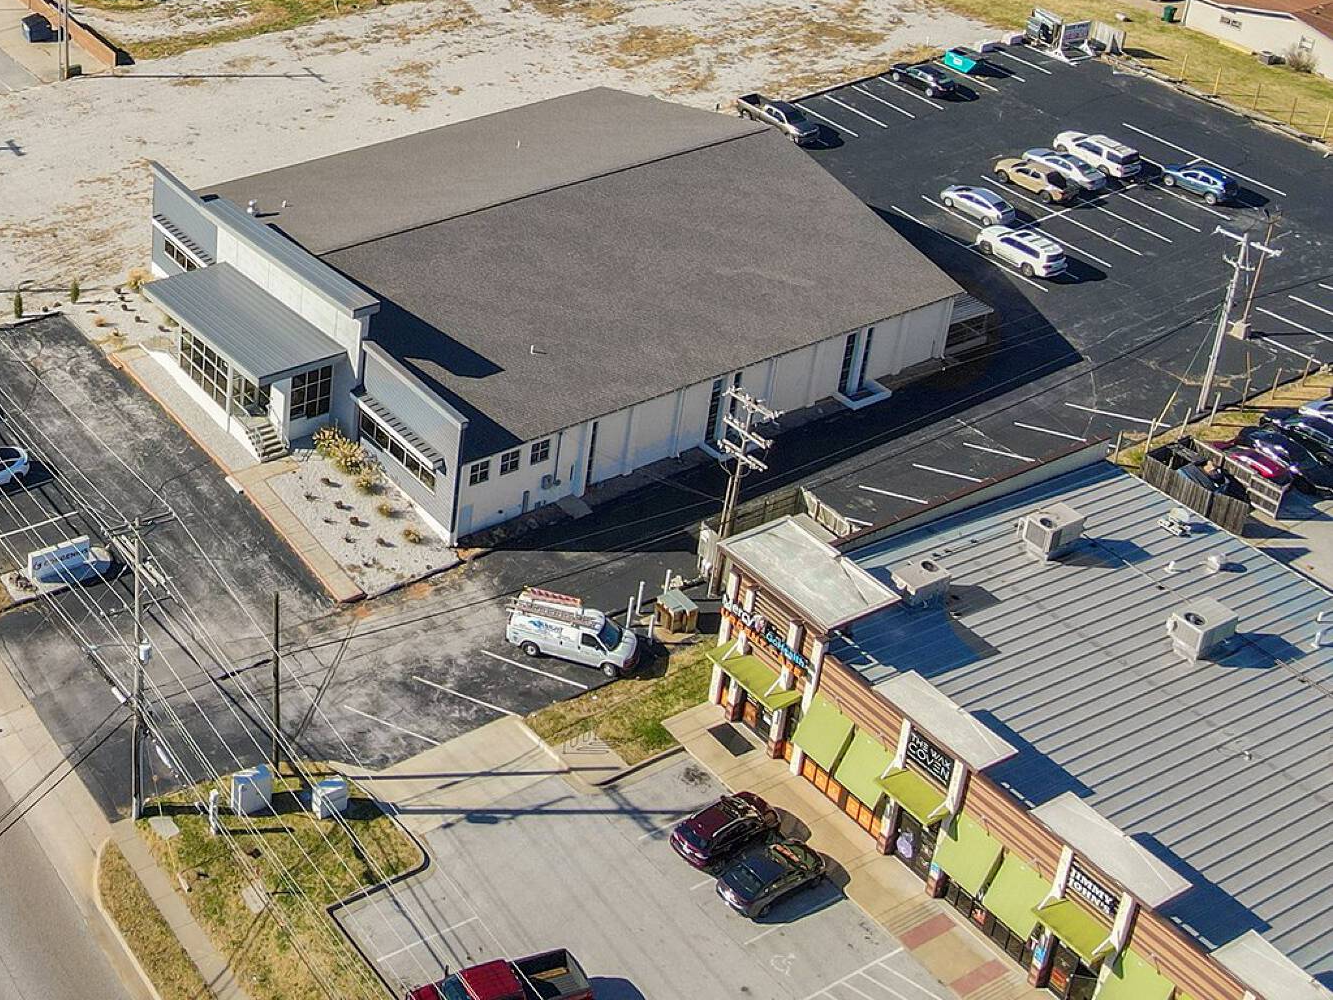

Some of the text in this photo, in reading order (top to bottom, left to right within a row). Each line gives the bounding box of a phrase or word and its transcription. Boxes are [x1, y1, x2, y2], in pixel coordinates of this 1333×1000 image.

[721, 593, 807, 669] Mercy GoHealth
[908, 742, 950, 780] COVEN
[910, 732, 952, 771] THE WAX
[1067, 877, 1111, 914] JOHN'S
[1070, 866, 1113, 904] JIMMY
